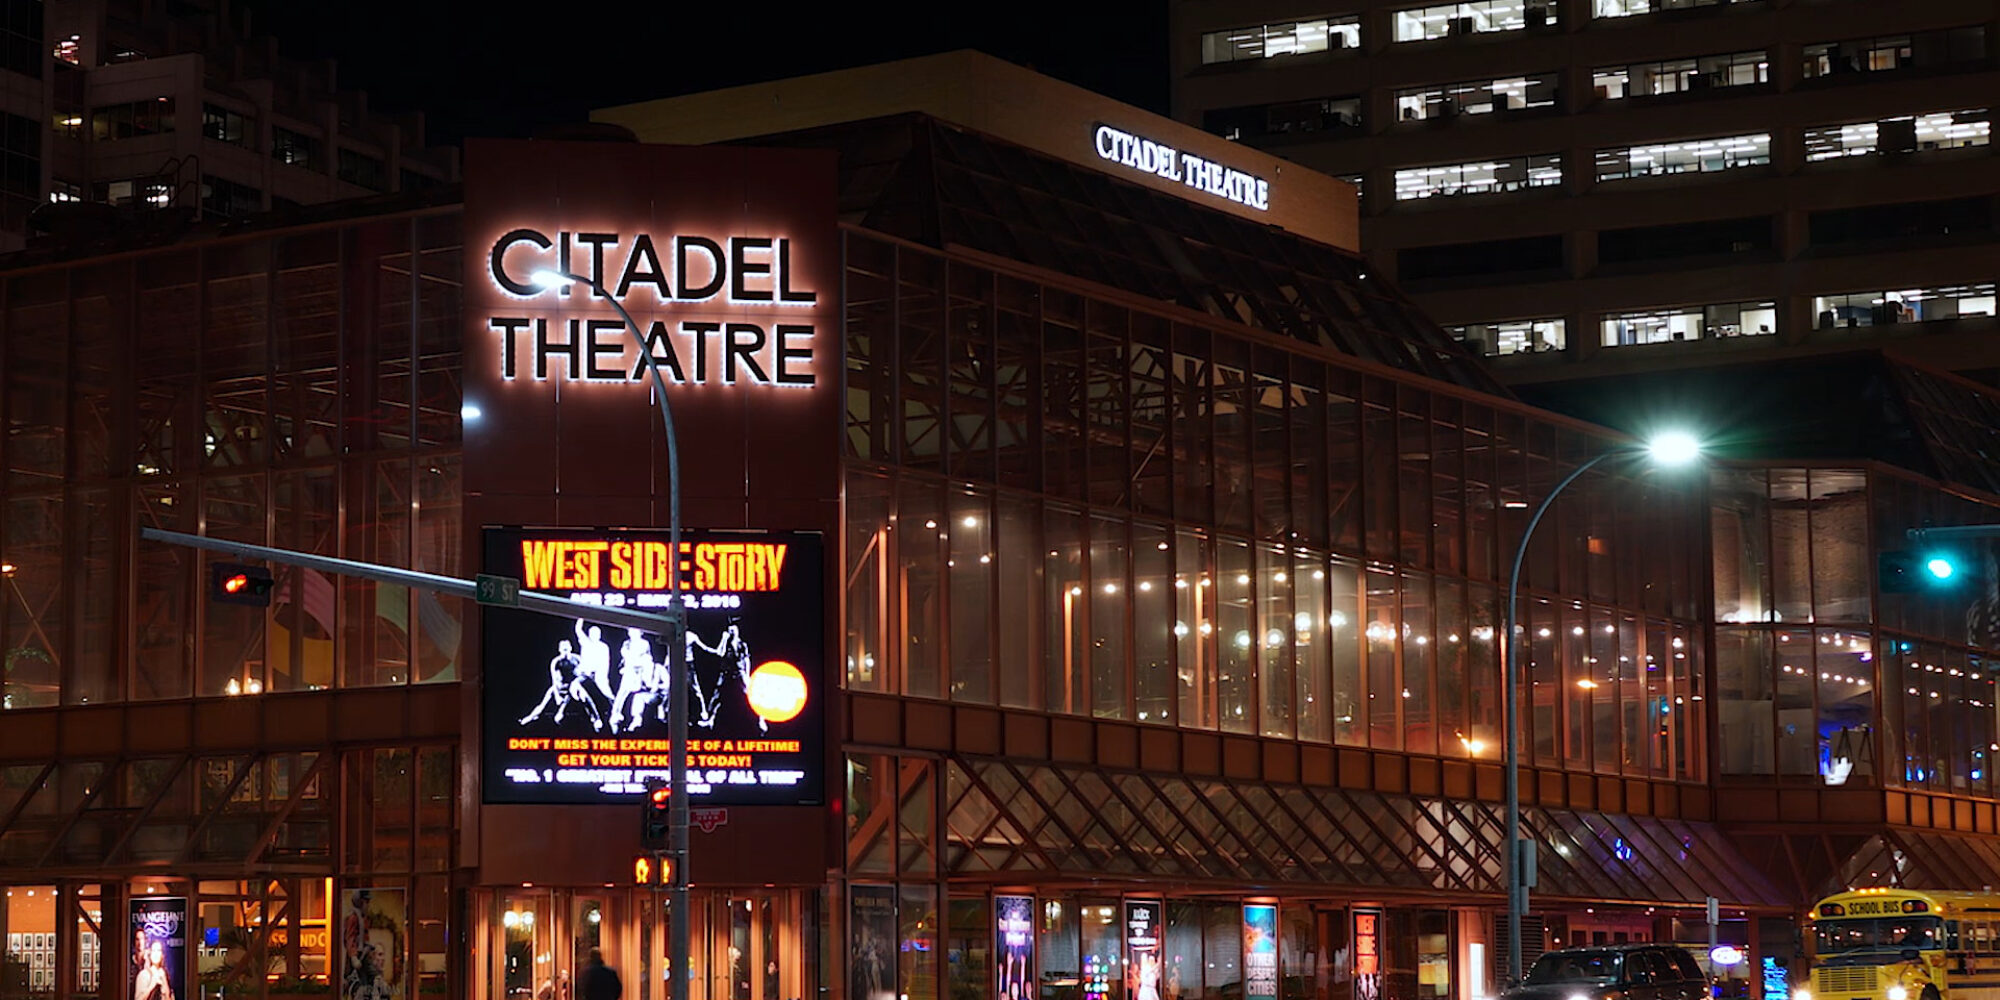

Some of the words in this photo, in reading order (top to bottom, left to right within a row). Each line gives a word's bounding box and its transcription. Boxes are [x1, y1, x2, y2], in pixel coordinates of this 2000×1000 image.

[1096, 126, 1181, 181] CITADEL
[1182, 153, 1268, 210] THEATRE
[487, 229, 816, 306] CITADEL
[487, 317, 816, 387] THEATRE
[522, 541, 609, 589] WEST
[609, 541, 691, 590] SIDE
[694, 543, 787, 591] STORY
[481, 580, 496, 598] 99
[502, 583, 514, 600] ST
[509, 738, 551, 750] DON'T
[553, 739, 589, 751] MISS
[591, 739, 618, 751] THE
[703, 740, 722, 752] OF
[723, 740, 734, 752] A
[737, 740, 800, 753] LIFETIME!
[558, 754, 587, 767] GET
[590, 754, 632, 767] YOUR
[633, 754, 696, 768] TICKS
[698, 754, 752, 768] TODAY!
[1849, 901, 1881, 915] SCHOOL
[1883, 900, 1900, 914] BUS
[131, 911, 185, 923] EVANGELINE
[1247, 952, 1275, 967] OTHER
[1247, 980, 1276, 996] CITIES
